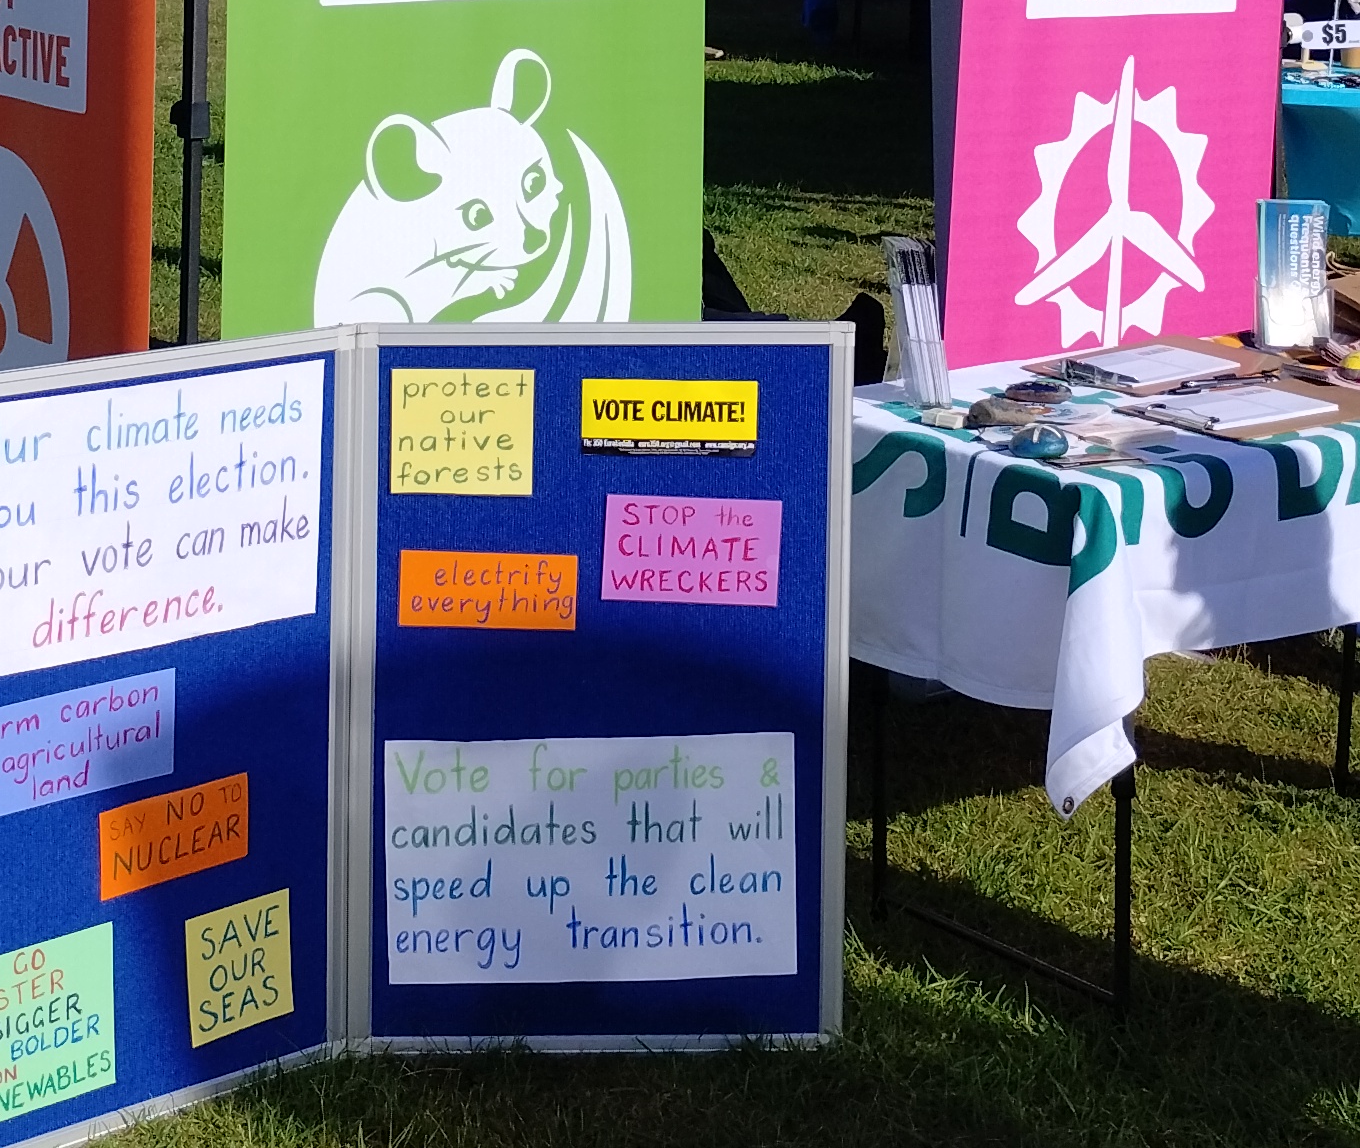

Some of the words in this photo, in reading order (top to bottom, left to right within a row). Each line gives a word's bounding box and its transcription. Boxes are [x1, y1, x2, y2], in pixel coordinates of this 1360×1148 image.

[1321, 23, 1347, 46] $5
[402, 372, 529, 409] protect
[592, 398, 645, 423] VOTE
[651, 400, 747, 424] CLIMATE!
[86, 388, 200, 453] climate
[220, 381, 303, 435] needs
[439, 404, 496, 426] our
[398, 429, 515, 452] native
[74, 463, 141, 517] this
[168, 442, 310, 505] election.
[396, 460, 524, 486] forests
[81, 521, 154, 577] vote
[176, 526, 225, 561] can
[240, 495, 311, 549] make
[621, 502, 698, 528] STOP
[715, 504, 755, 528] the
[617, 533, 760, 562] CLIMATE
[434, 558, 564, 594] electrify
[610, 568, 769, 593] WRECKERS
[32, 584, 225, 649] difference.
[410, 587, 575, 625] everything
[60, 685, 160, 724] carbon
[1, 711, 161, 784] agricultural
[31, 766, 90, 801] land
[394, 748, 491, 795] Vote
[529, 743, 588, 792] for
[613, 744, 726, 805] parties
[759, 758, 781, 787] &
[109, 811, 147, 841] SAY
[166, 789, 205, 825] NO
[219, 781, 244, 807] TO
[391, 800, 598, 850] candidates
[626, 797, 702, 844] that
[729, 792, 784, 842] will
[111, 812, 242, 881] NUCLEAR
[394, 857, 493, 918] speed
[526, 875, 571, 915] up
[605, 853, 659, 898] the
[689, 853, 782, 897] clean
[201, 904, 280, 961] SAVE
[395, 923, 522, 970] energy
[566, 902, 764, 950] transition.
[13, 948, 47, 976] GO
[209, 947, 266, 993] OUR
[198, 974, 280, 1034] SEAS
[10, 1014, 100, 1062] BOLDER
